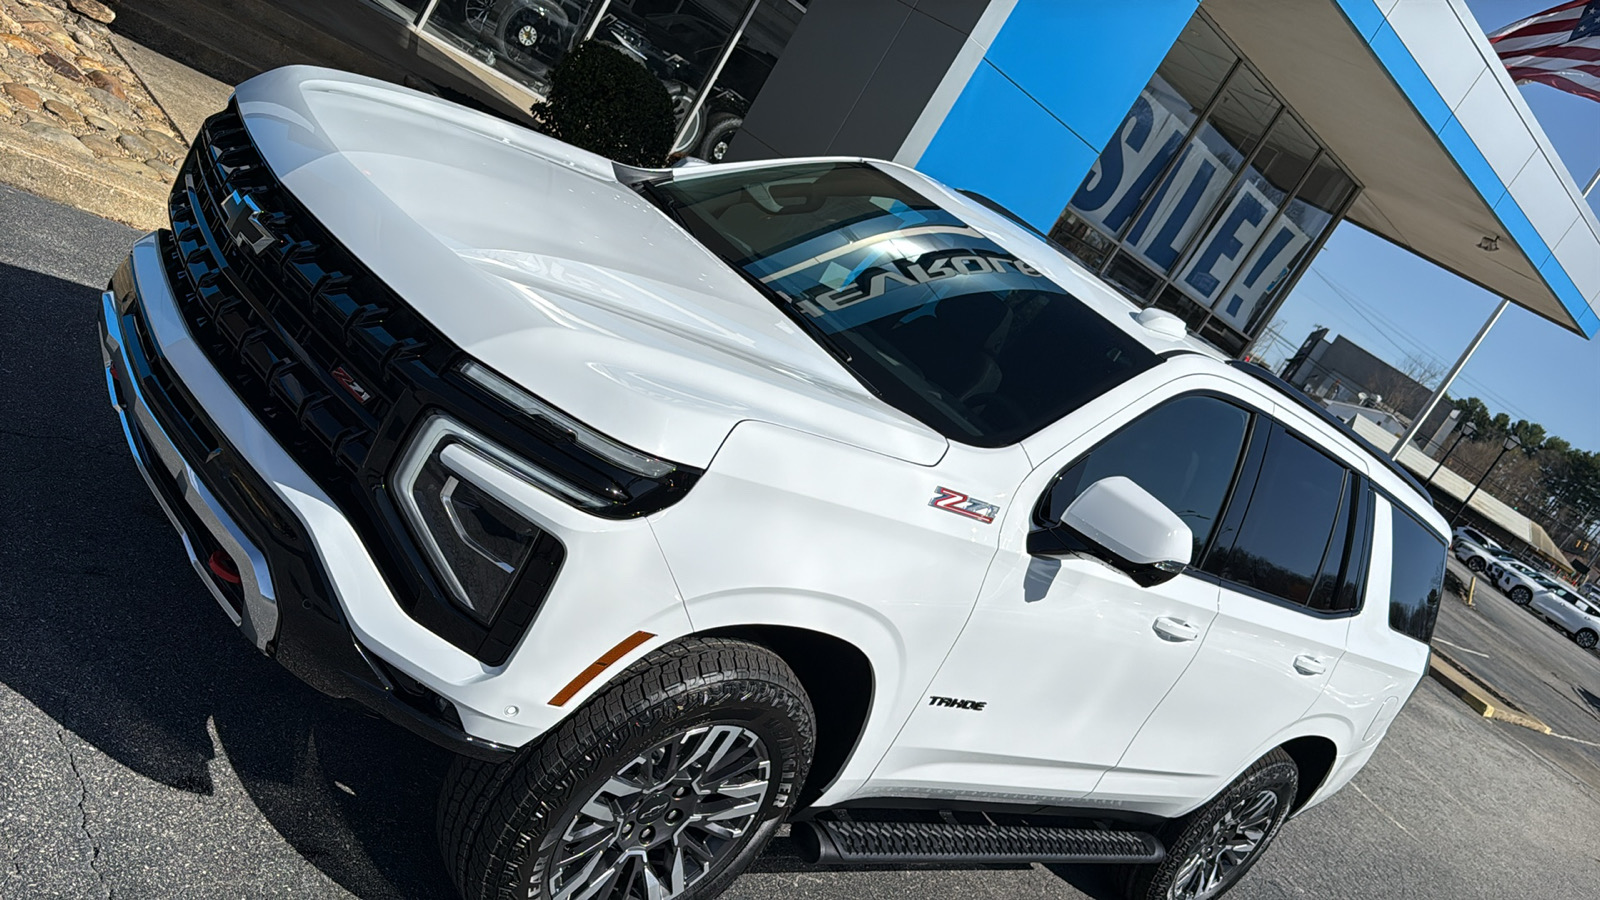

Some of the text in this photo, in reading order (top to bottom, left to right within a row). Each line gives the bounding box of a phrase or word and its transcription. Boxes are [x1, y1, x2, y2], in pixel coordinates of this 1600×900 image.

[1070, 95, 1295, 318] SALE!
[331, 367, 371, 403] Z71
[928, 485, 1000, 524] Z71
[929, 696, 987, 711] TAHOE
